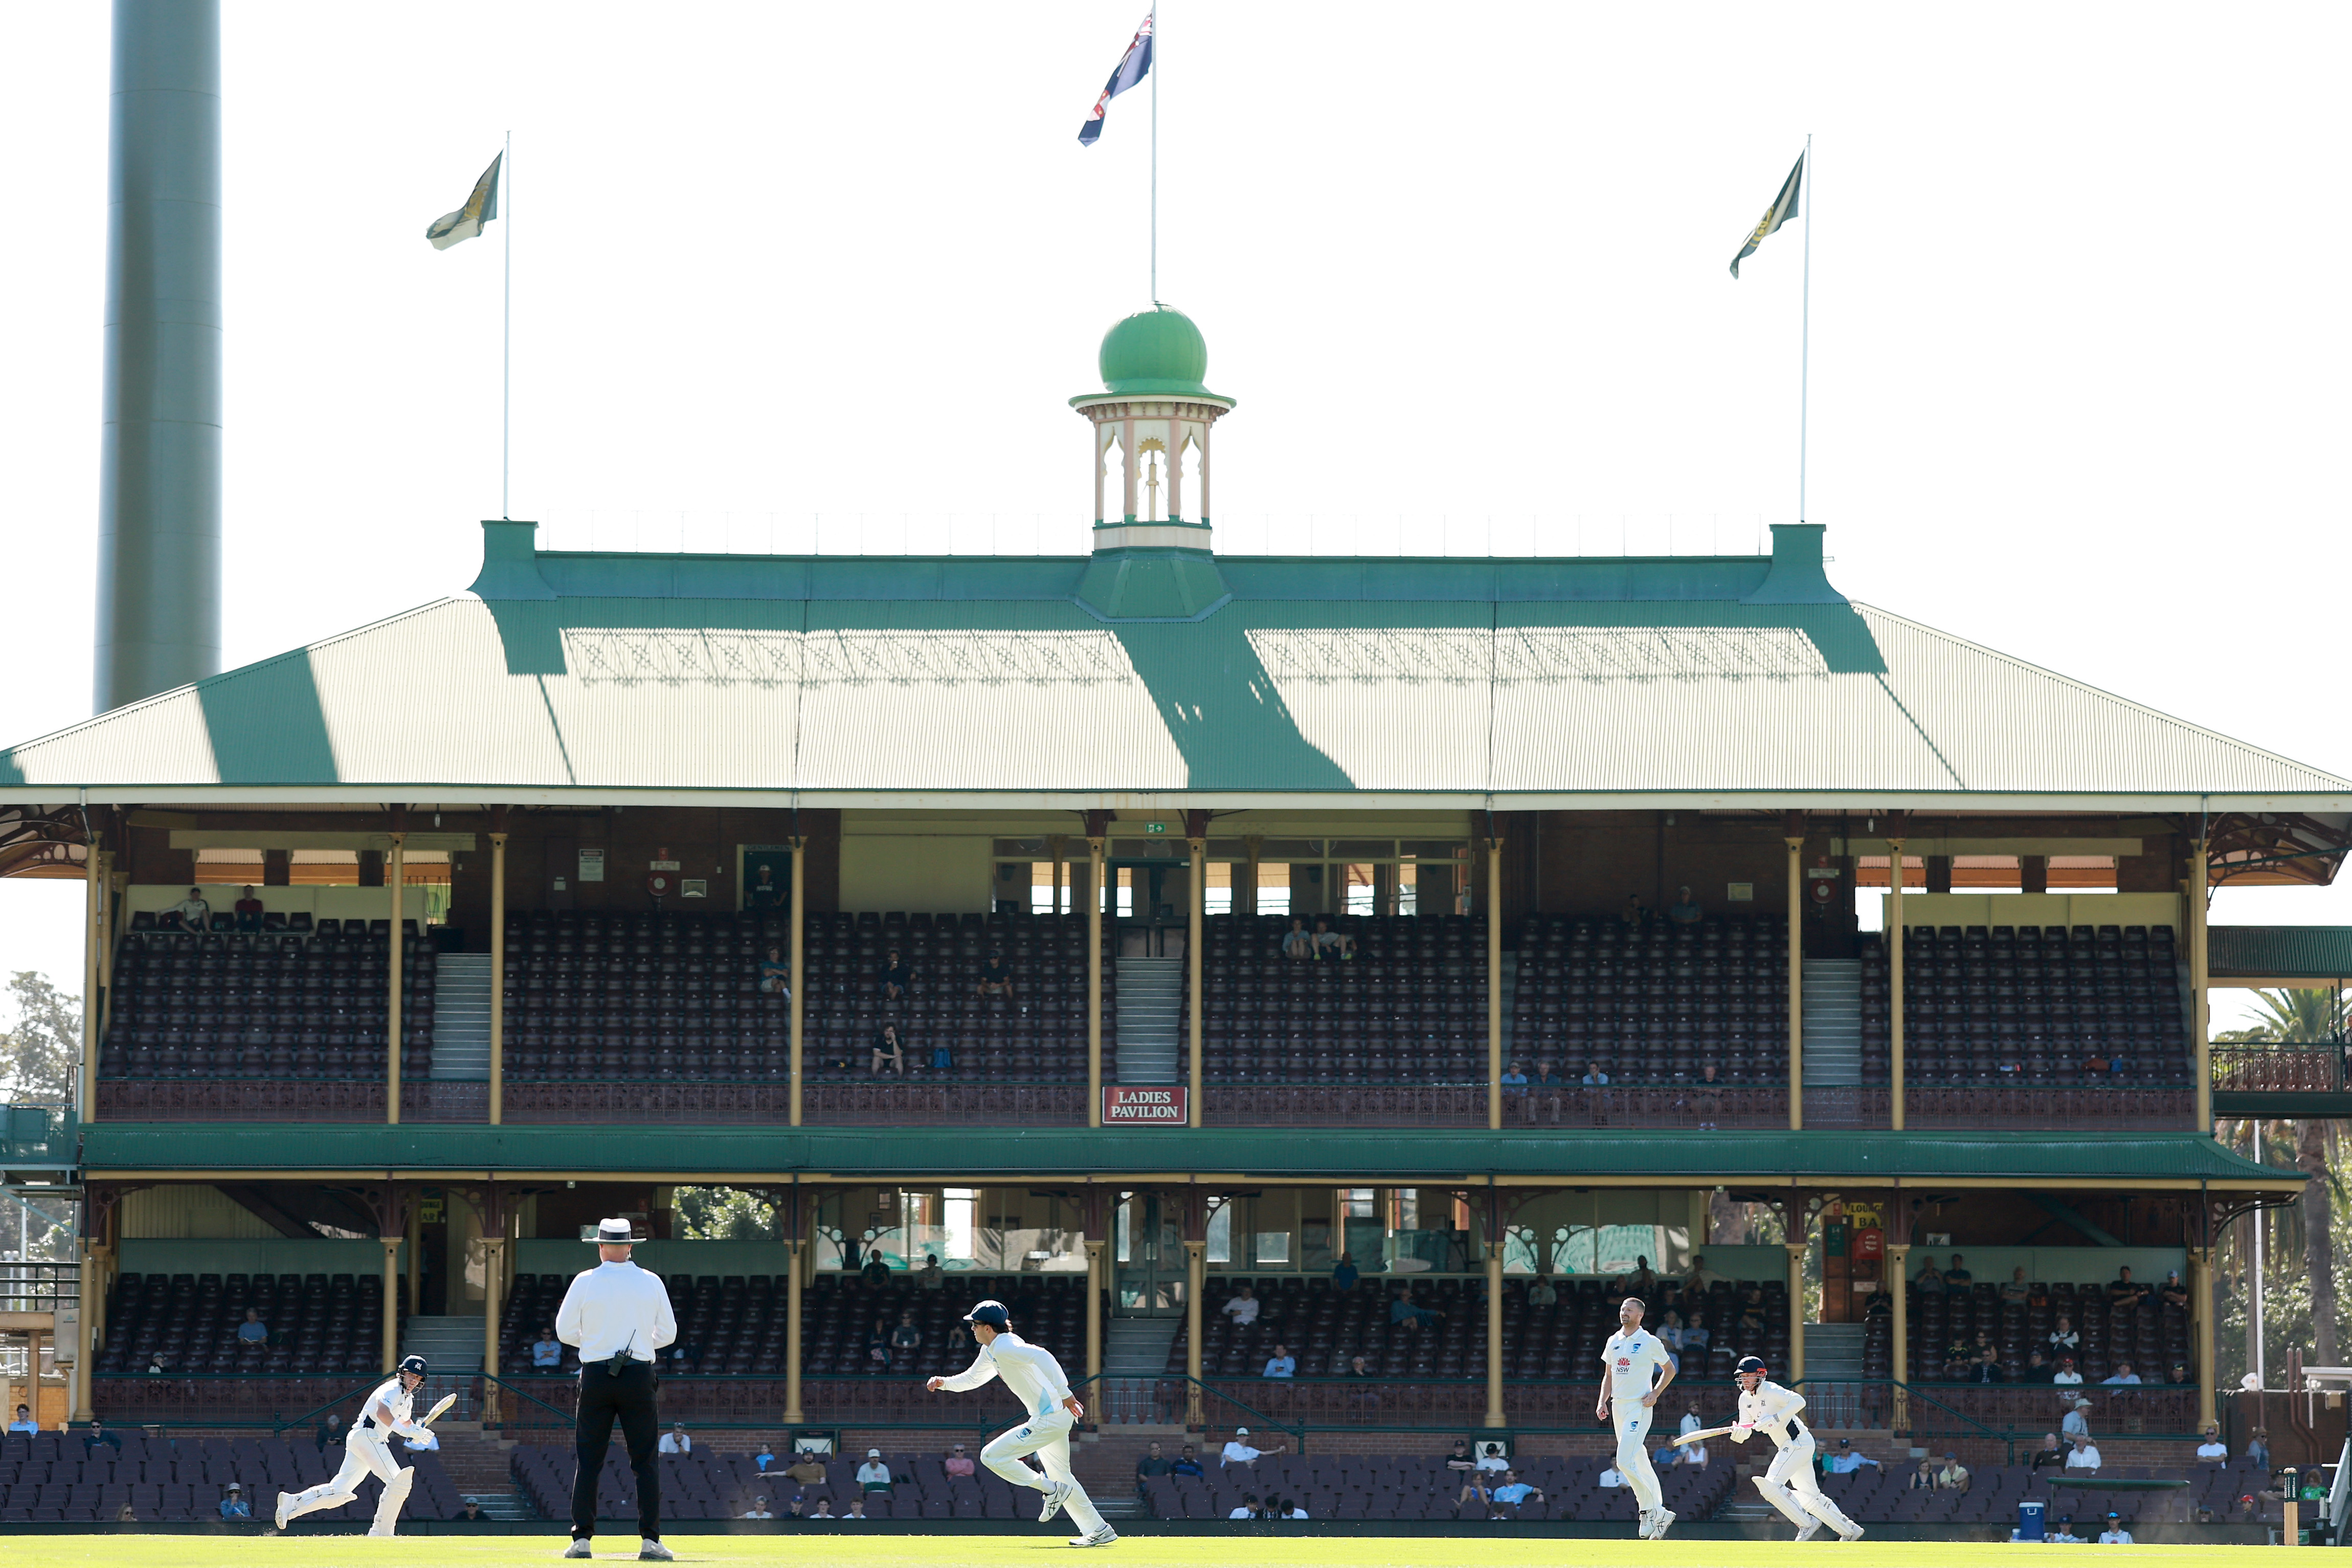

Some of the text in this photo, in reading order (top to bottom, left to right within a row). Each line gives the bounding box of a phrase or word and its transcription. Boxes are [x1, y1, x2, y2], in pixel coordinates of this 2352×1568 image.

[1119, 1091, 1171, 1103] LADIES
[1111, 1106, 1178, 1117] PAVILION
[1860, 1218, 1877, 1226] BA
